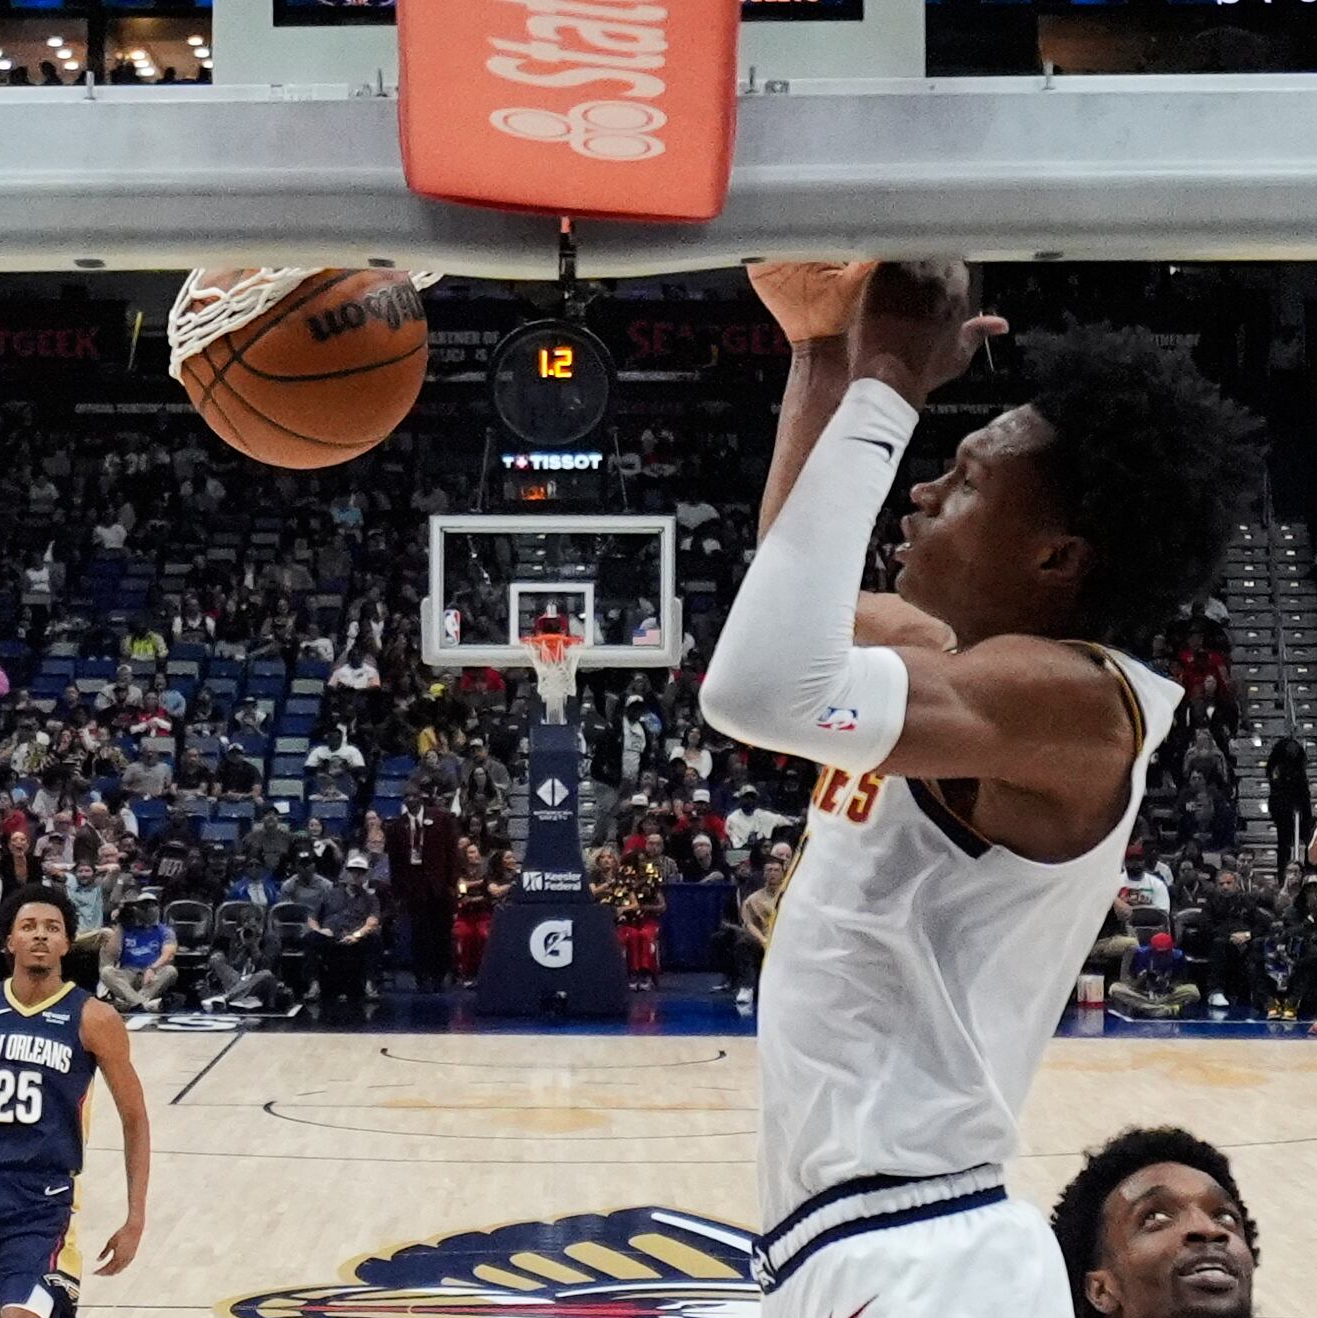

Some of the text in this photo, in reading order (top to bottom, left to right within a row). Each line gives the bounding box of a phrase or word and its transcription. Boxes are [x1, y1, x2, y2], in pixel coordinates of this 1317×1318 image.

[486, 0, 669, 98] Stat
[540, 348, 573, 378] 1.2
[530, 919, 574, 968] G
[5, 1033, 73, 1074] ORLEANS
